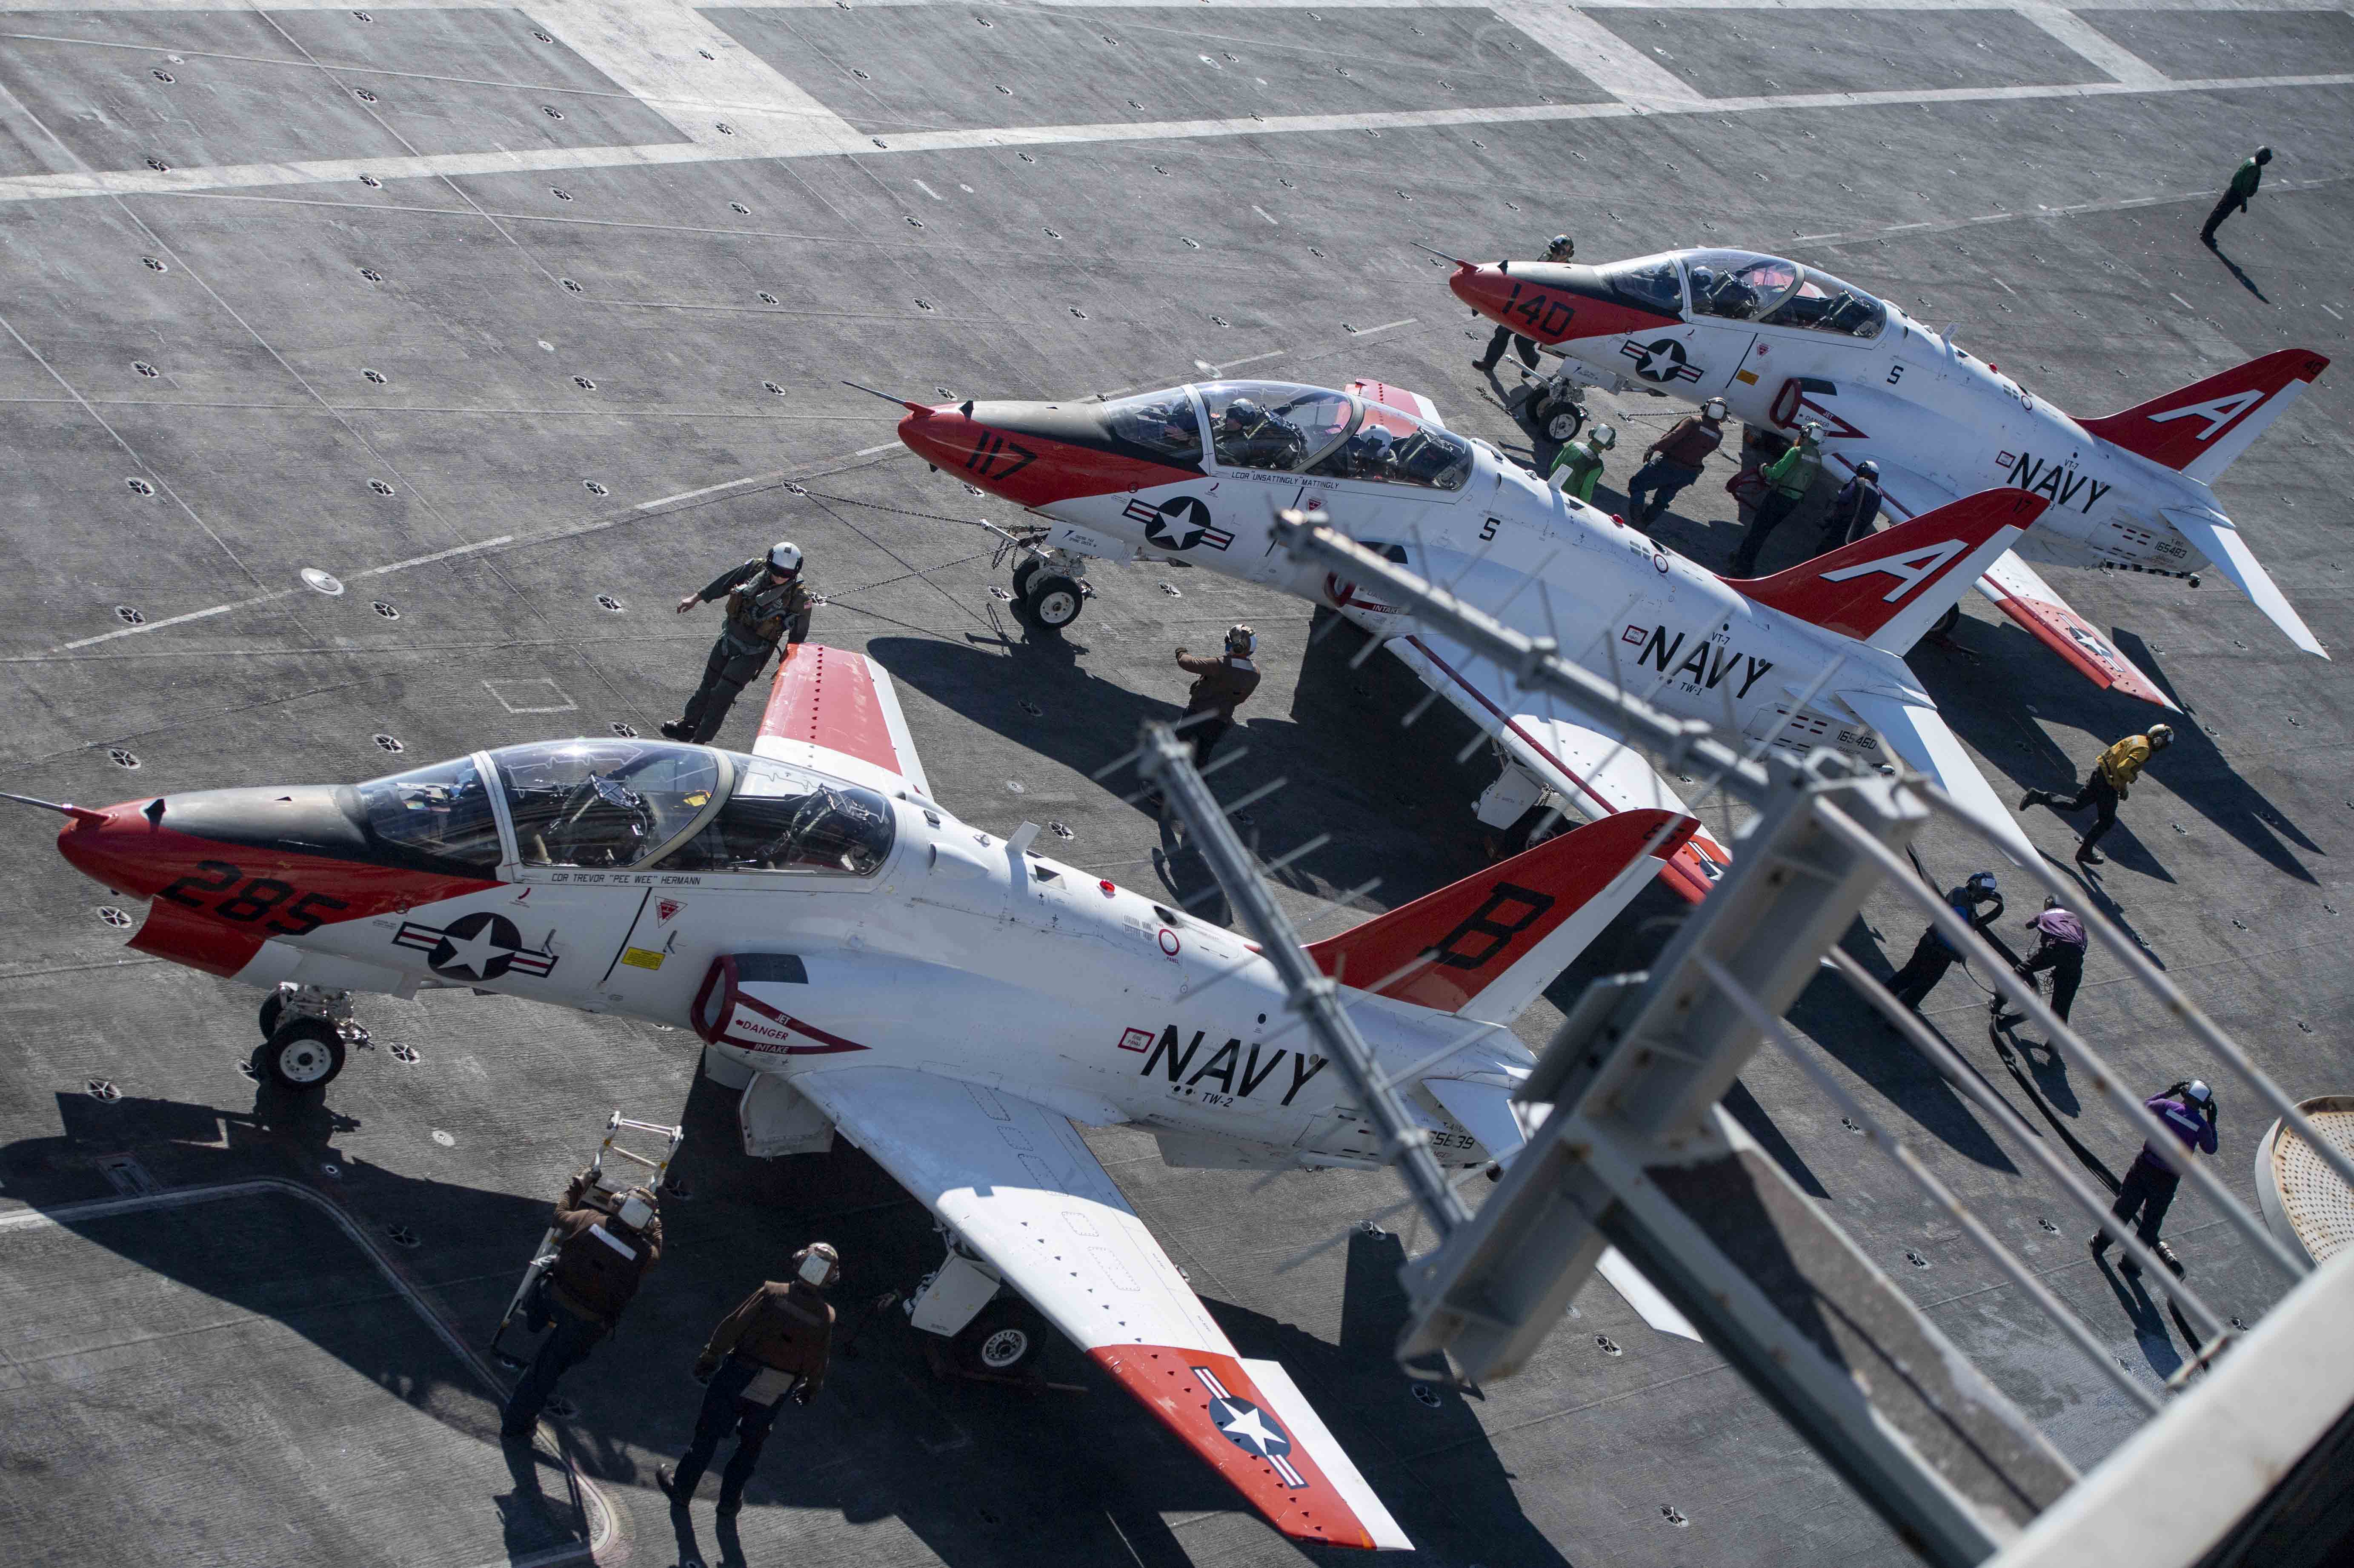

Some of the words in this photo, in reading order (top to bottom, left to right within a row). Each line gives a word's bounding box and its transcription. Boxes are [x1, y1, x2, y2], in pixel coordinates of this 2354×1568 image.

[1502, 283, 1576, 337] 140
[2305, 360, 2324, 375] 40
[1823, 411, 1833, 420] JET
[2146, 389, 2265, 441] A
[966, 430, 1038, 481] 117
[2065, 458, 2079, 470] VT-7
[2006, 452, 2111, 514] NAVY
[2155, 541, 2187, 558] 165483
[1818, 538, 1969, 603] A
[1372, 604, 1400, 614] INTAKE
[1712, 632, 1730, 645] VT-7
[1637, 625, 1775, 699] NAVY
[1680, 682, 1702, 696] TW-1
[1836, 730, 1877, 750] 165460
[552, 873, 569, 882] CDR
[573, 874, 605, 883] TREVOR
[661, 876, 701, 885] HERMANN
[158, 860, 351, 936] 285
[1416, 881, 1556, 970] B
[775, 1013, 791, 1025] JET
[742, 1021, 789, 1041] DANGER
[753, 1043, 790, 1054] INTAKE
[1140, 1024, 1330, 1106] NAVY
[1201, 1092, 1234, 1107] TW-2
